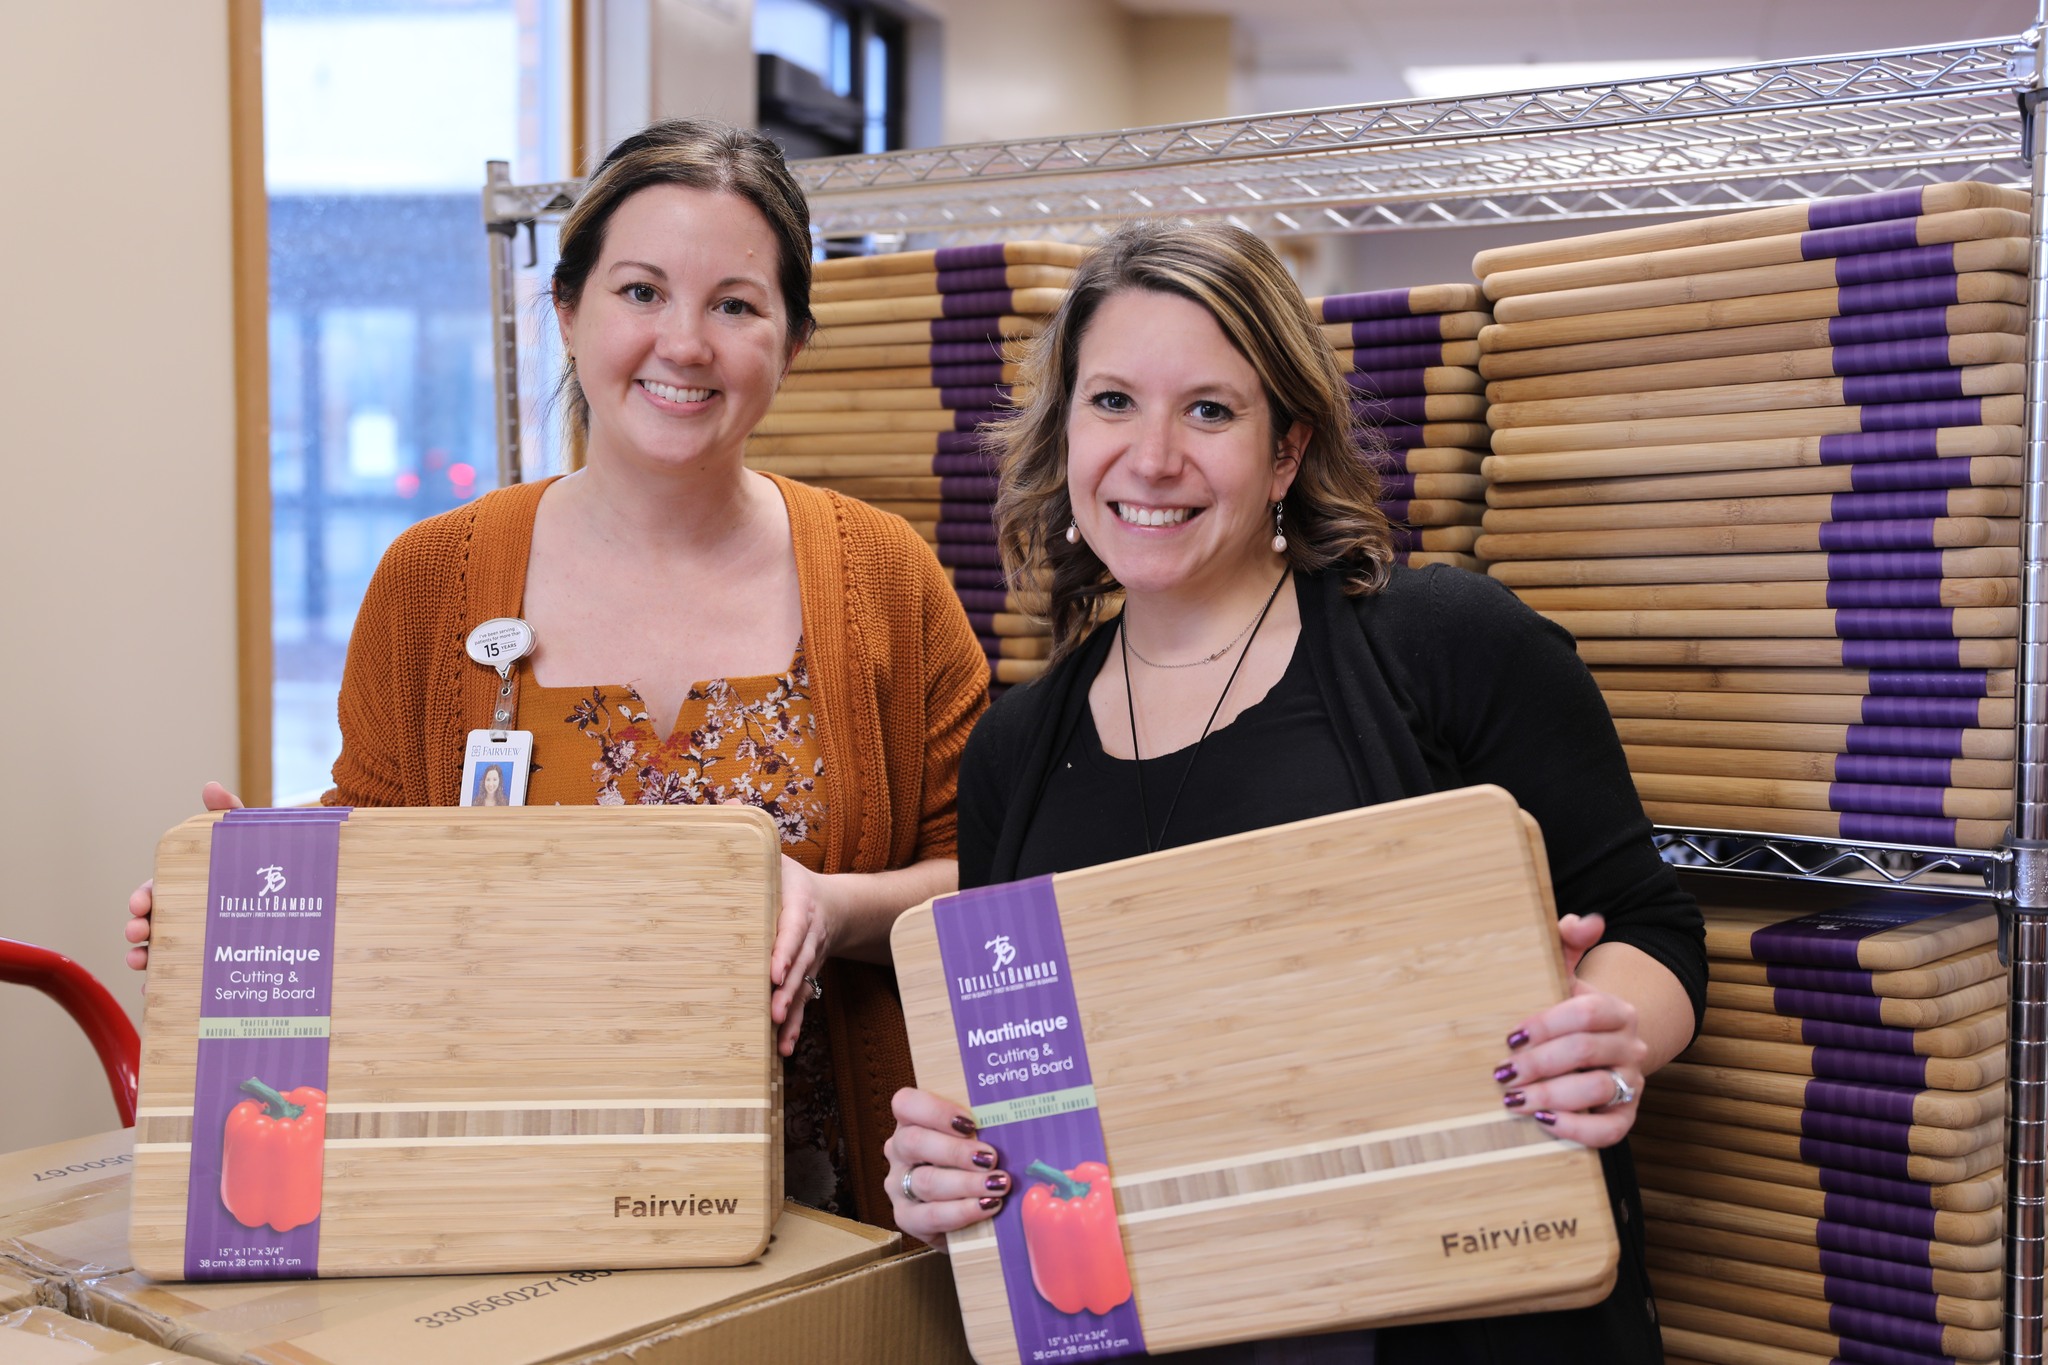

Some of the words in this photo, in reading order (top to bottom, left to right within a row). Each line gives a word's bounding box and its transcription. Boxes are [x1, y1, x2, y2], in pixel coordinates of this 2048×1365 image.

[483, 642, 500, 658] 15
[214, 945, 321, 965] Martinique
[230, 970, 284, 985] Cutting
[288, 971, 299, 983] &
[215, 987, 268, 1003] Serving
[272, 987, 315, 999] Board
[968, 1015, 1069, 1048] Martinique
[987, 1047, 1040, 1067] Cutting
[1042, 1043, 1054, 1056] &
[978, 1067, 1029, 1087] Serving
[1031, 1056, 1074, 1077] Board
[614, 1193, 738, 1218] Fairview
[1441, 1218, 1577, 1257] Fairview
[199, 1259, 210, 1268] 38
[235, 1258, 246, 1267] 28
[248, 1259, 263, 1267] cm
[272, 1257, 285, 1266] 1.9
[286, 1258, 301, 1266] cm
[219, 1248, 233, 1257] 15"
[242, 1247, 257, 1256] 11"
[264, 1247, 284, 1256] 3/4"
[414, 1269, 622, 1329] 33056027185
[1048, 1336, 1061, 1347] 15"
[1069, 1333, 1083, 1344] 11"
[1090, 1329, 1108, 1340] 3/4"
[1033, 1350, 1044, 1360] 38
[1045, 1349, 1059, 1358] cm
[1066, 1345, 1077, 1355] 28
[1078, 1344, 1093, 1353] cm
[1093, 1343, 1099, 1351] x
[1100, 1339, 1112, 1349] 1.9
[1113, 1338, 1129, 1347] cm
